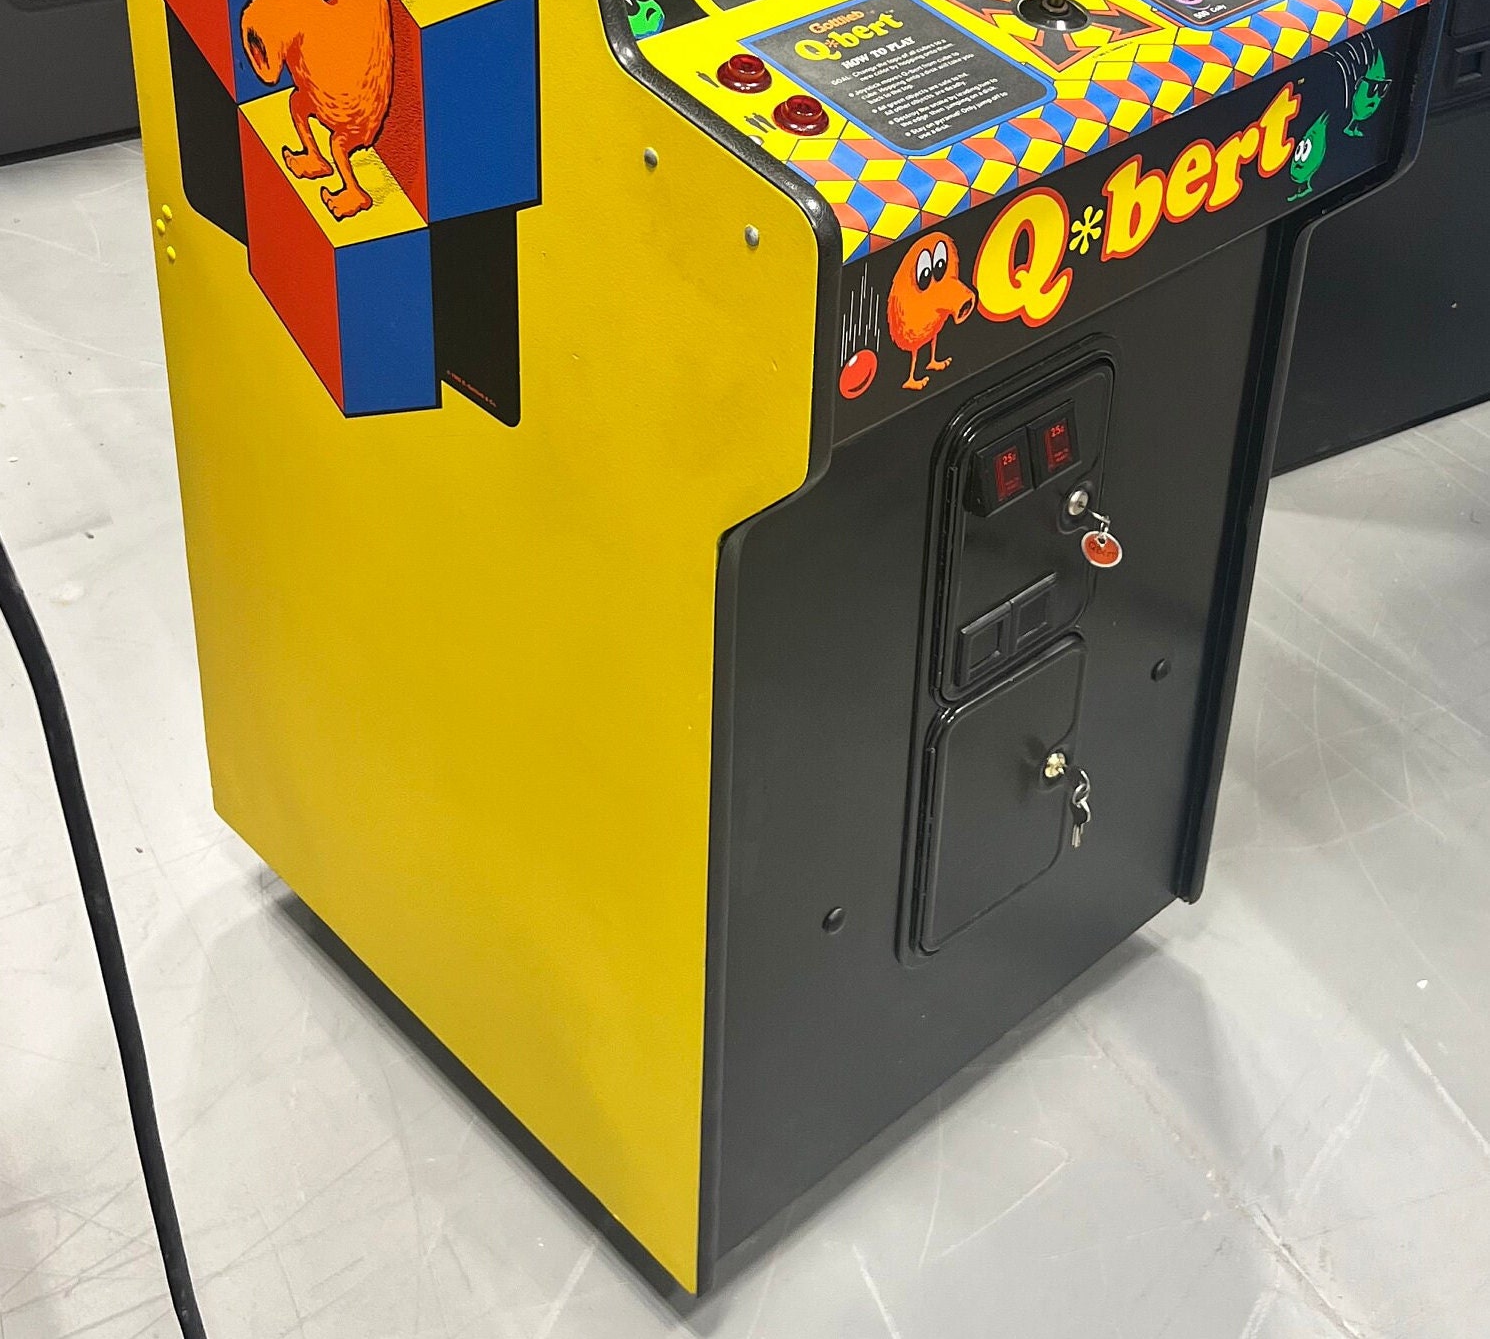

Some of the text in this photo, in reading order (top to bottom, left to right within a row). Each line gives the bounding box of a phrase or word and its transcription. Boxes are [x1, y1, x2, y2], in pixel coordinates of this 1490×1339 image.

[808, 10, 865, 34] Gottlieb
[841, 36, 915, 69] HOW TO PLAY
